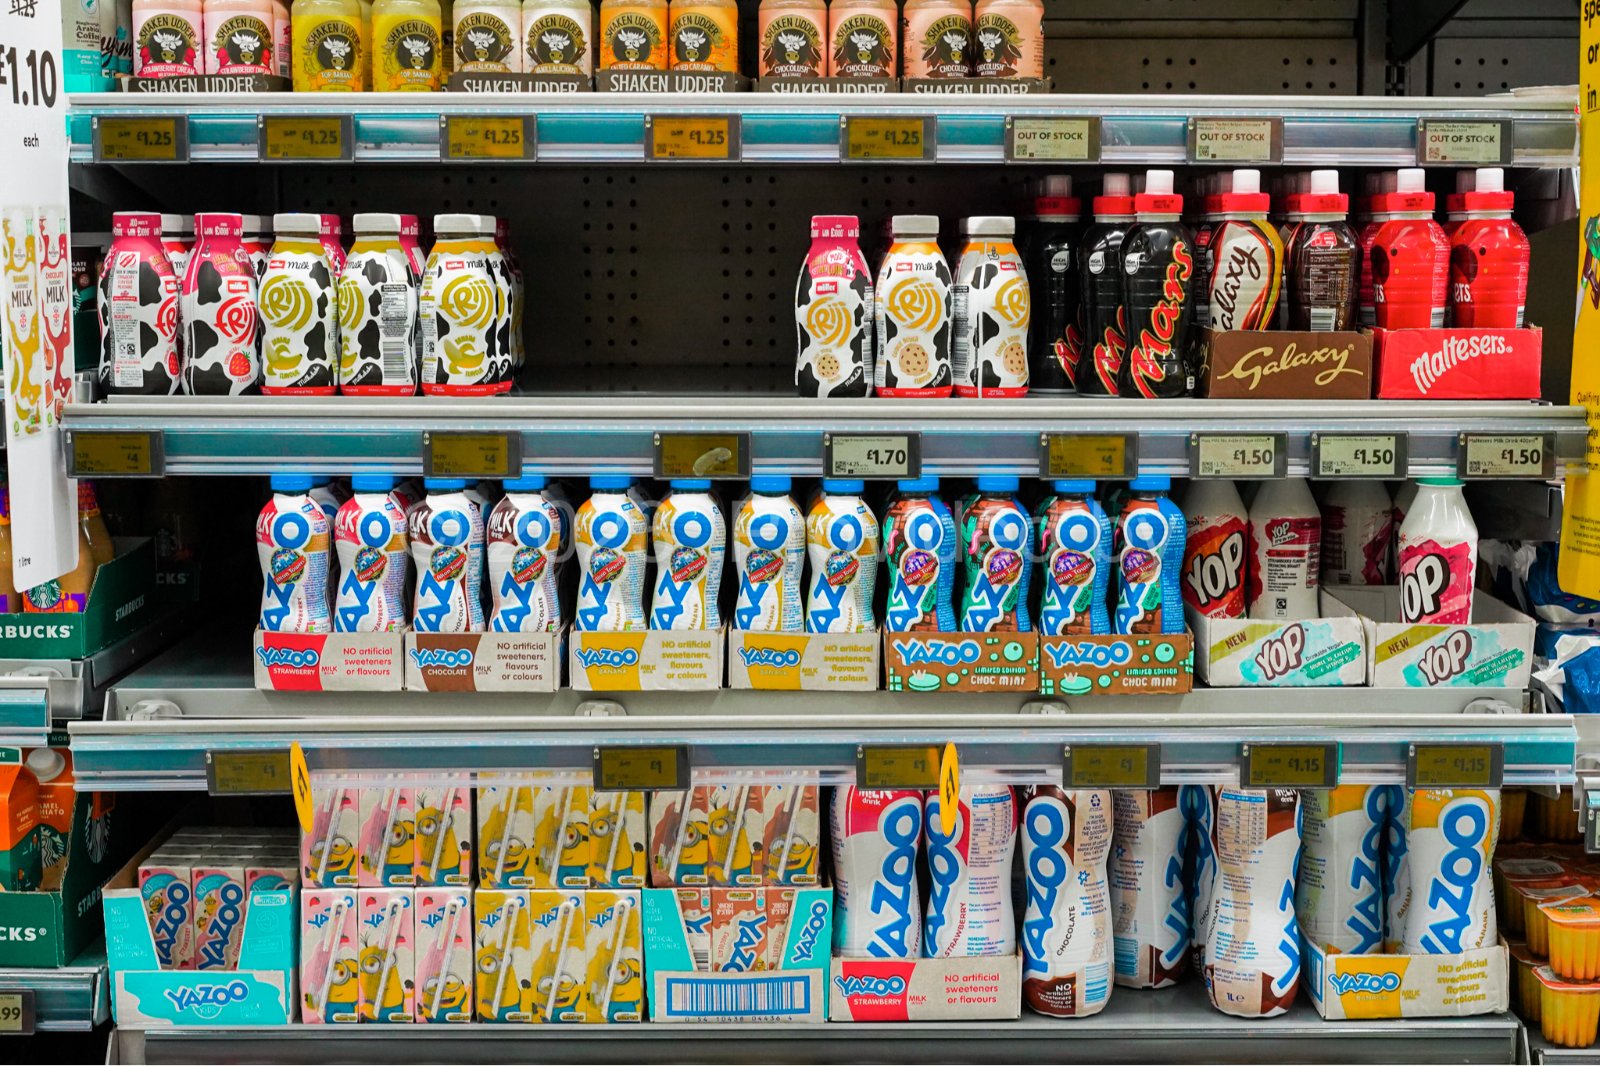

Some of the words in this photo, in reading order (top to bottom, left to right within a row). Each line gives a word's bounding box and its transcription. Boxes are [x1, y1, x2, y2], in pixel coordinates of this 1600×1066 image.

[610, 74, 668, 93] SHAKEN
[675, 75, 724, 93] UDDER
[23, 133, 40, 148] each
[136, 131, 172, 146] £1.25
[302, 130, 338, 145] £1.25
[484, 129, 520, 145] £1.25
[689, 129, 725, 145] £1.25
[884, 129, 920, 145] £1.25
[1018, 131, 1036, 140] OUT
[1040, 131, 1051, 140] OF
[1053, 131, 1083, 140] STOCK
[1200, 133, 1219, 141] OUT
[1221, 133, 1233, 141] OF
[1235, 133, 1265, 141] STOCK
[1430, 135, 1449, 143] OUT
[1452, 135, 1463, 143] OF
[1465, 135, 1495, 143] STOCK
[287, 260, 310, 270] Milk
[915, 262, 934, 271] Milk
[11, 289, 33, 309] MILK
[46, 285, 65, 304] MILK
[1130, 241, 1194, 398] Mars
[1217, 342, 1363, 390] Galaxy
[1410, 335, 1506, 395] Maltesers
[867, 448, 906, 465] £1.70
[1233, 449, 1273, 465] £1.50
[1354, 448, 1394, 465] £1.50
[1502, 448, 1541, 465] £1.50
[1271, 520, 1290, 538] YOP
[1186, 530, 1245, 606] YOP
[115, 593, 145, 622] STARBUCKS
[497, 642, 511, 650] NO
[512, 642, 546, 650] artificial
[661, 641, 675, 649] NO
[677, 641, 711, 649] artificial
[1225, 631, 1247, 649] NEW
[1387, 636, 1410, 655] NEW
[256, 646, 318, 667] YAZOO
[343, 647, 357, 656] NO
[359, 647, 393, 656] artificial
[410, 648, 473, 668] YAZOO
[497, 653, 547, 662] sweeteners,
[575, 648, 639, 668] YAZOO
[662, 652, 711, 660] sweeteners,
[737, 648, 801, 668] YAZOO
[893, 638, 981, 666] YAZOO
[1045, 641, 1133, 668] YAZOO
[1256, 623, 1305, 681] YOP
[1419, 630, 1472, 685] YOP
[344, 658, 392, 666] sweeteners
[505, 662, 539, 671] flavours
[670, 661, 704, 670] flavours
[273, 668, 316, 676] STRAWBERRY
[357, 667, 391, 676] flavours
[512, 672, 543, 681] colours
[676, 671, 707, 679] colours
[970, 676, 997, 685] CHOC
[1122, 678, 1149, 687] CHOC
[1288, 757, 1320, 772] £1.15
[862, 798, 882, 806] drink
[197, 883, 243, 970] YAZOO
[792, 902, 828, 962] YAZOO
[944, 902, 967, 957] STRAWBERRY
[1056, 905, 1076, 957] CHOCOLATE
[1475, 909, 1489, 948] BANANA
[944, 974, 959, 982] NO
[962, 973, 1000, 982] artificial
[1328, 973, 1401, 994] YAZOO
[835, 976, 906, 997] YAZOO
[945, 985, 999, 993] sweeteners
[1056, 982, 1072, 991] NO
[167, 981, 249, 1011] YAZOO
[853, 998, 902, 1006] STRAWBERRY
[959, 995, 997, 1004] flavours
